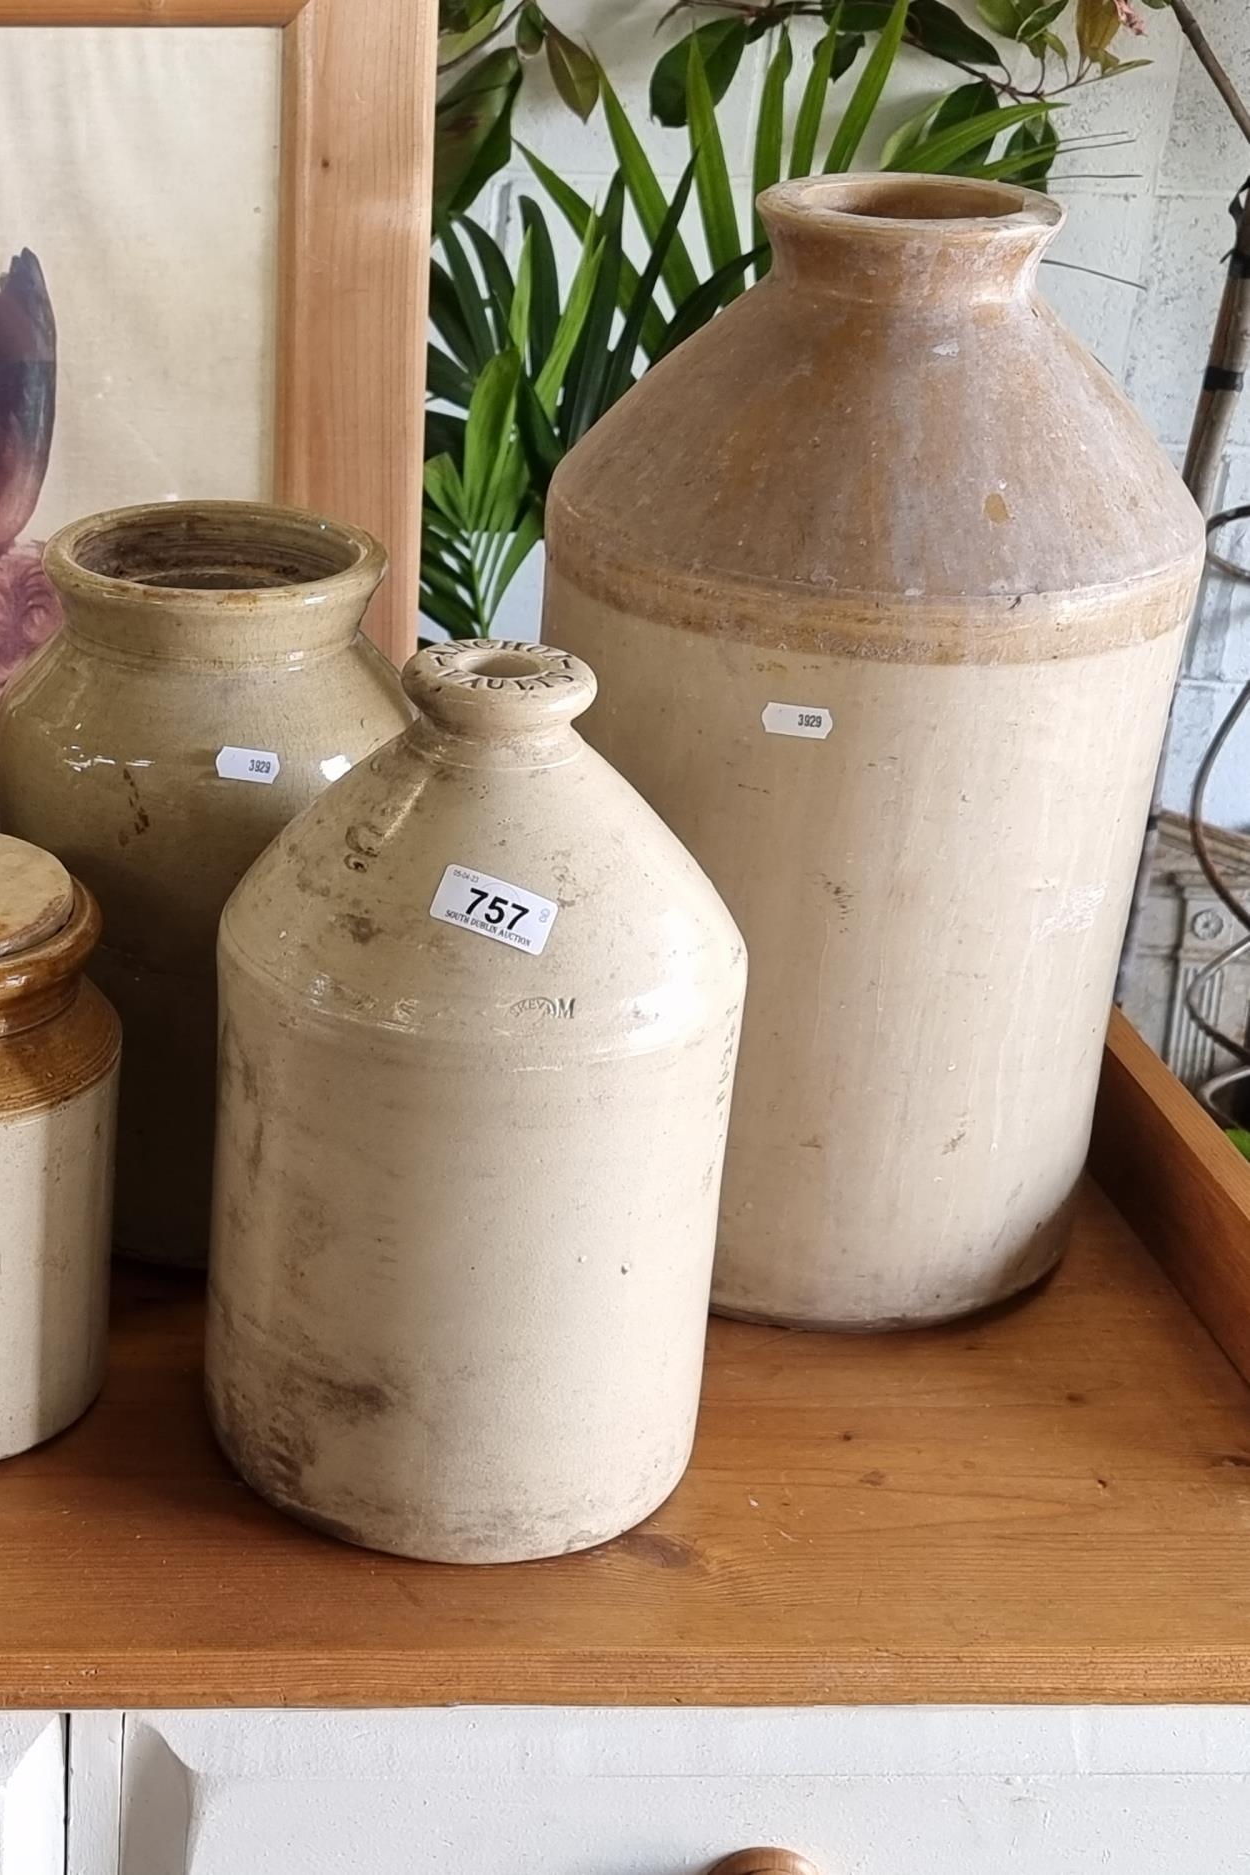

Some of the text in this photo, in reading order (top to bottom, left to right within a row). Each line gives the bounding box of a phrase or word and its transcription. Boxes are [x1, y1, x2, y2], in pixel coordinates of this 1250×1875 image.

[438, 669, 575, 691] VAULTS
[797, 713, 823, 728] 3929
[248, 759, 271, 774] 3929
[465, 887, 530, 931] 757
[444, 909, 532, 947] SOUTH DUBLIN AUCTION
